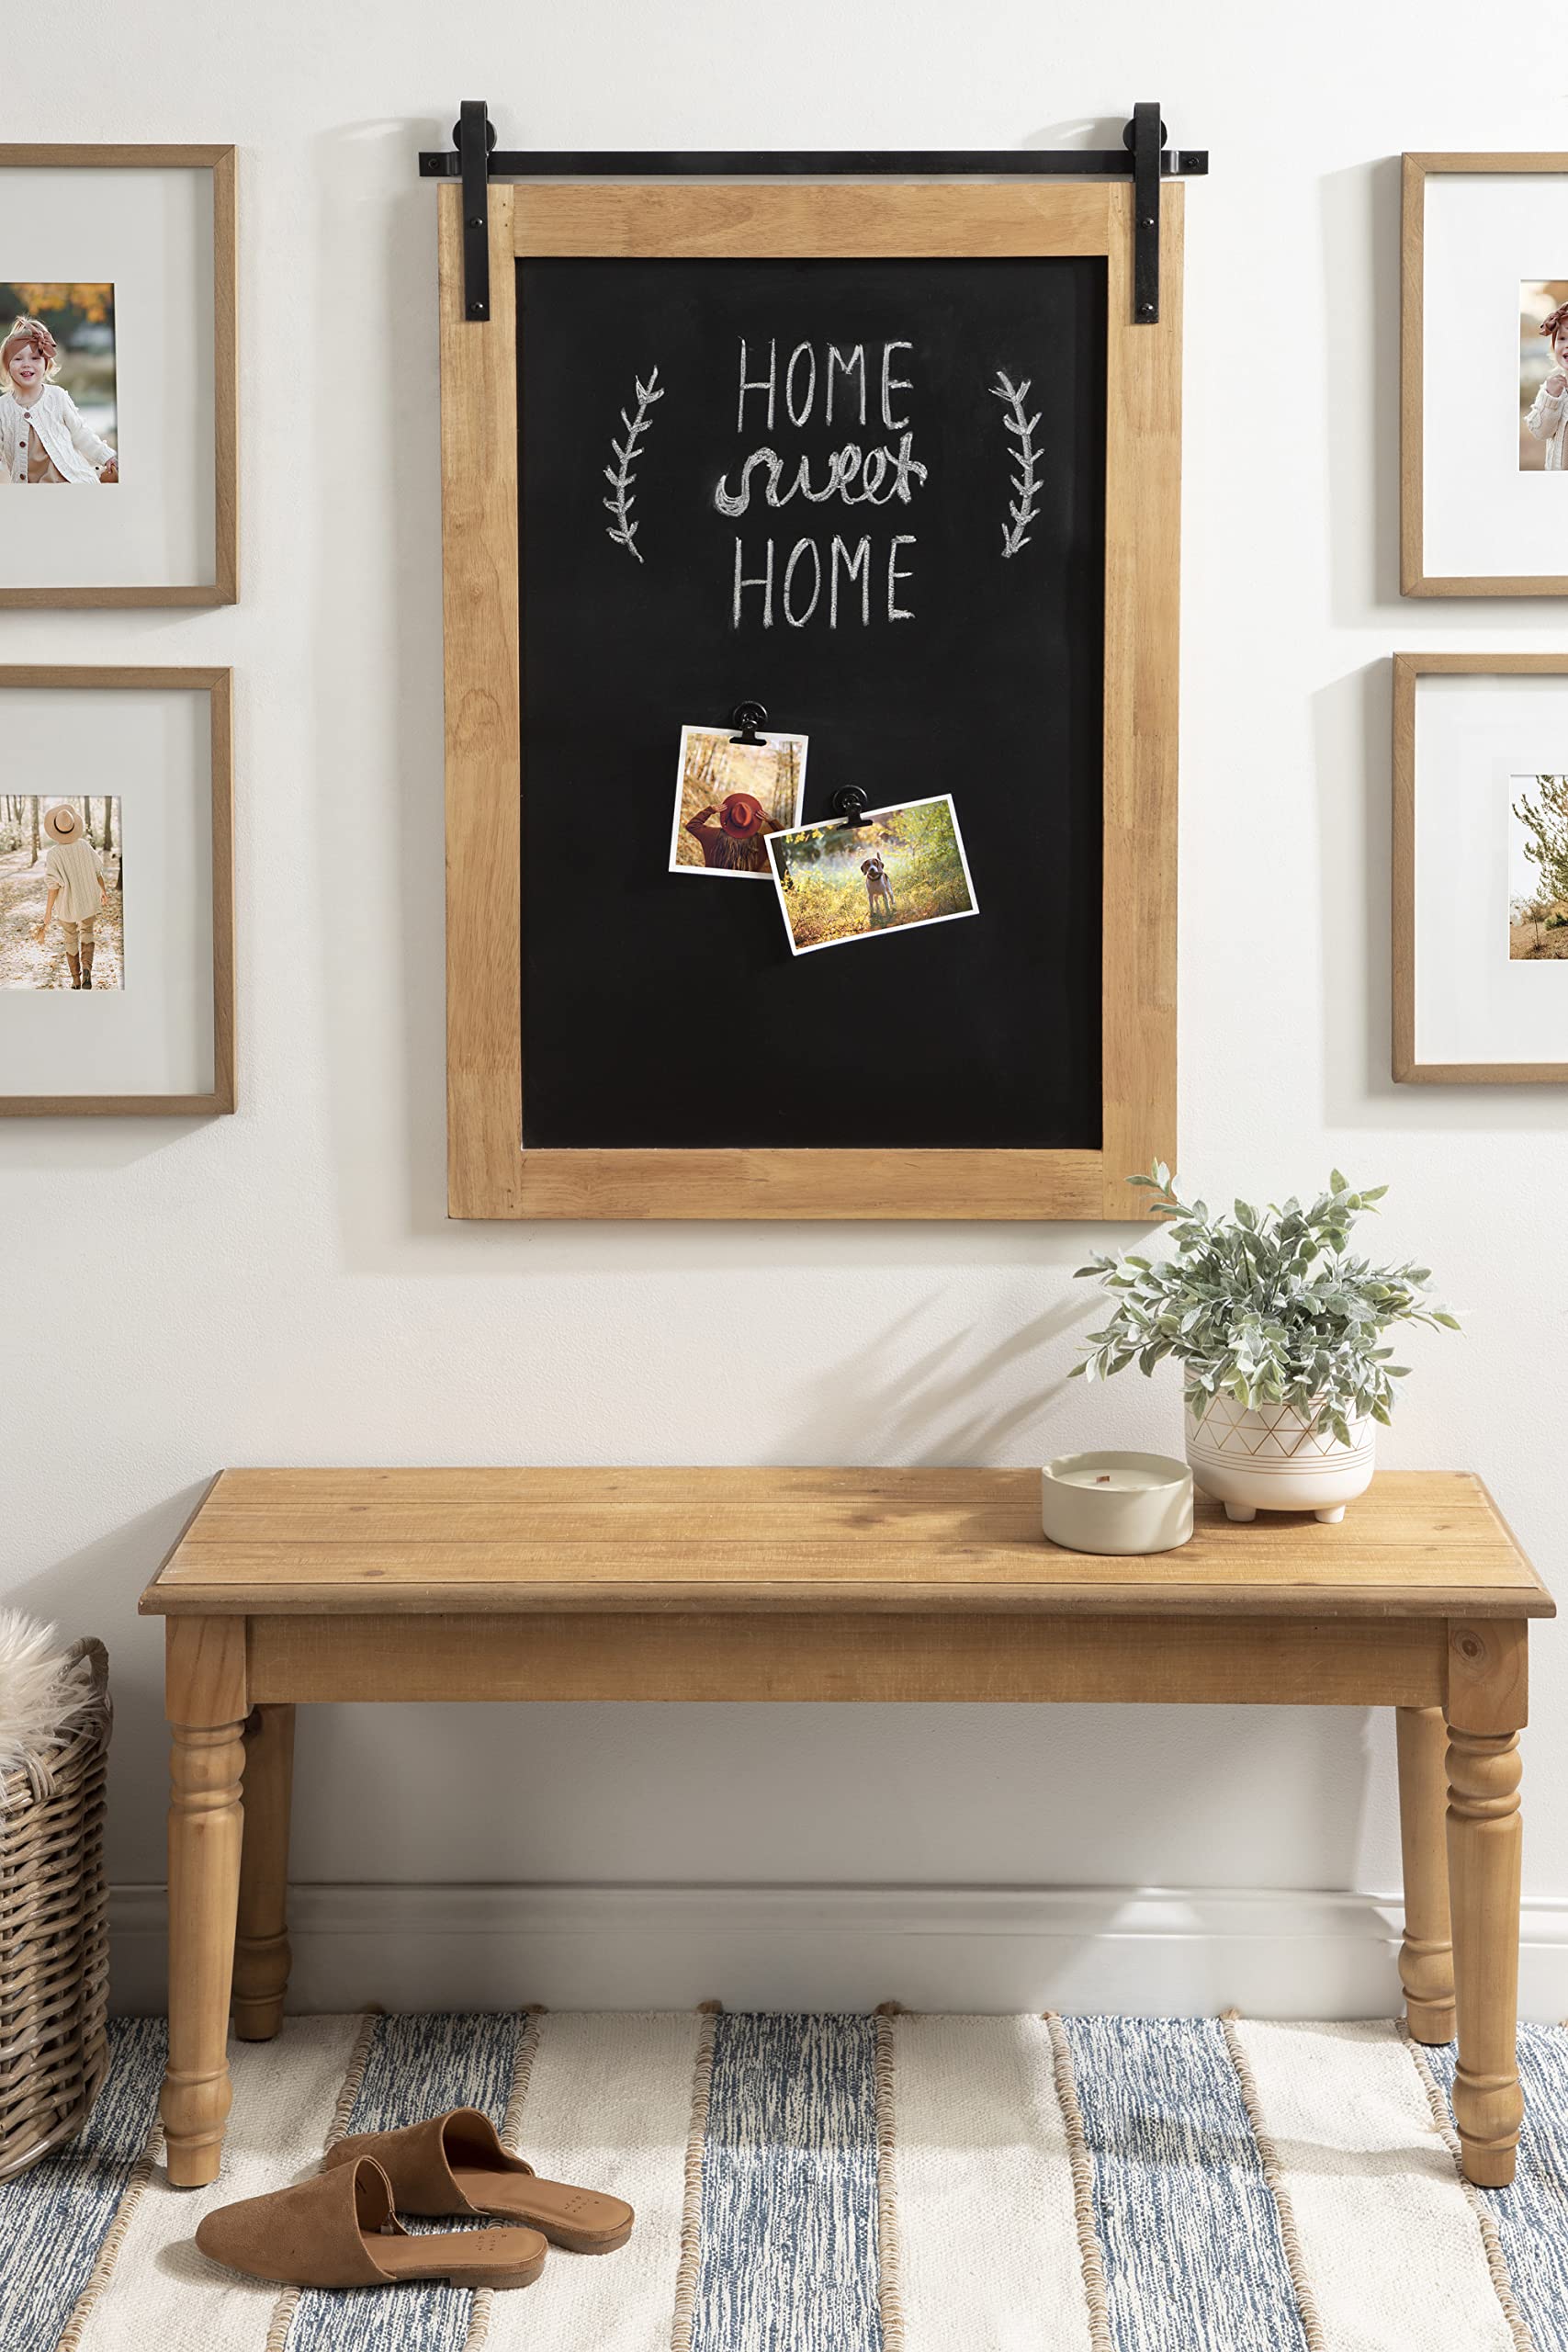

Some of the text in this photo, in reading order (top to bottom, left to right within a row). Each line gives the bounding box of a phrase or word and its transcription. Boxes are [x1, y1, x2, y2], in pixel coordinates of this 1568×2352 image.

[738, 337, 915, 433] HOME
[714, 431, 928, 517] sweet
[732, 534, 917, 629] HOME
